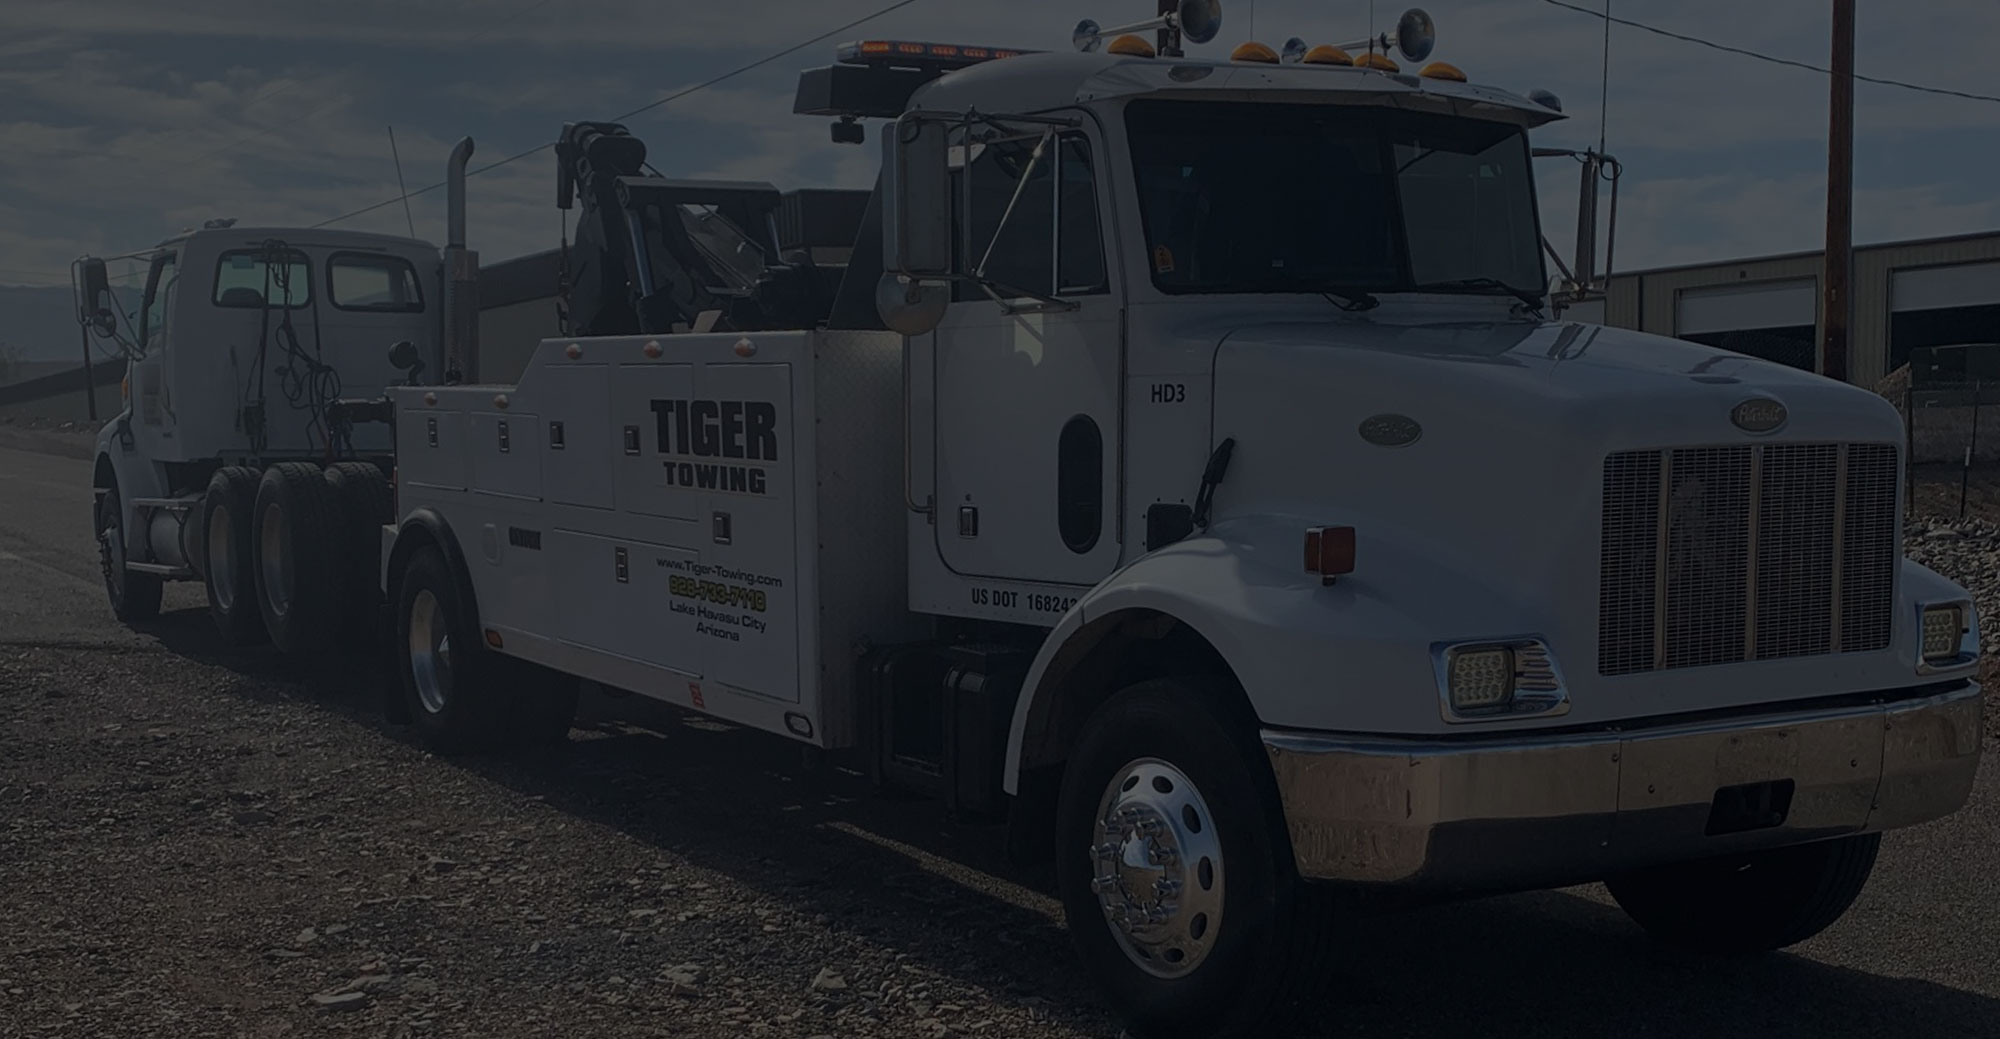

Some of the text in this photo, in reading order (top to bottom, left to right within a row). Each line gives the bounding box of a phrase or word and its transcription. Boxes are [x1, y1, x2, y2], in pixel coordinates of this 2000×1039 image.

[1151, 383, 1186, 403] HD3
[650, 399, 778, 461] TIGER
[663, 462, 766, 494] TOWING
[656, 557, 783, 588] www.Tiger-Towing.com
[971, 587, 989, 606] US
[992, 590, 1019, 609] DOT
[669, 599, 767, 634] Lake Havasu City
[696, 621, 740, 642] Arizona
